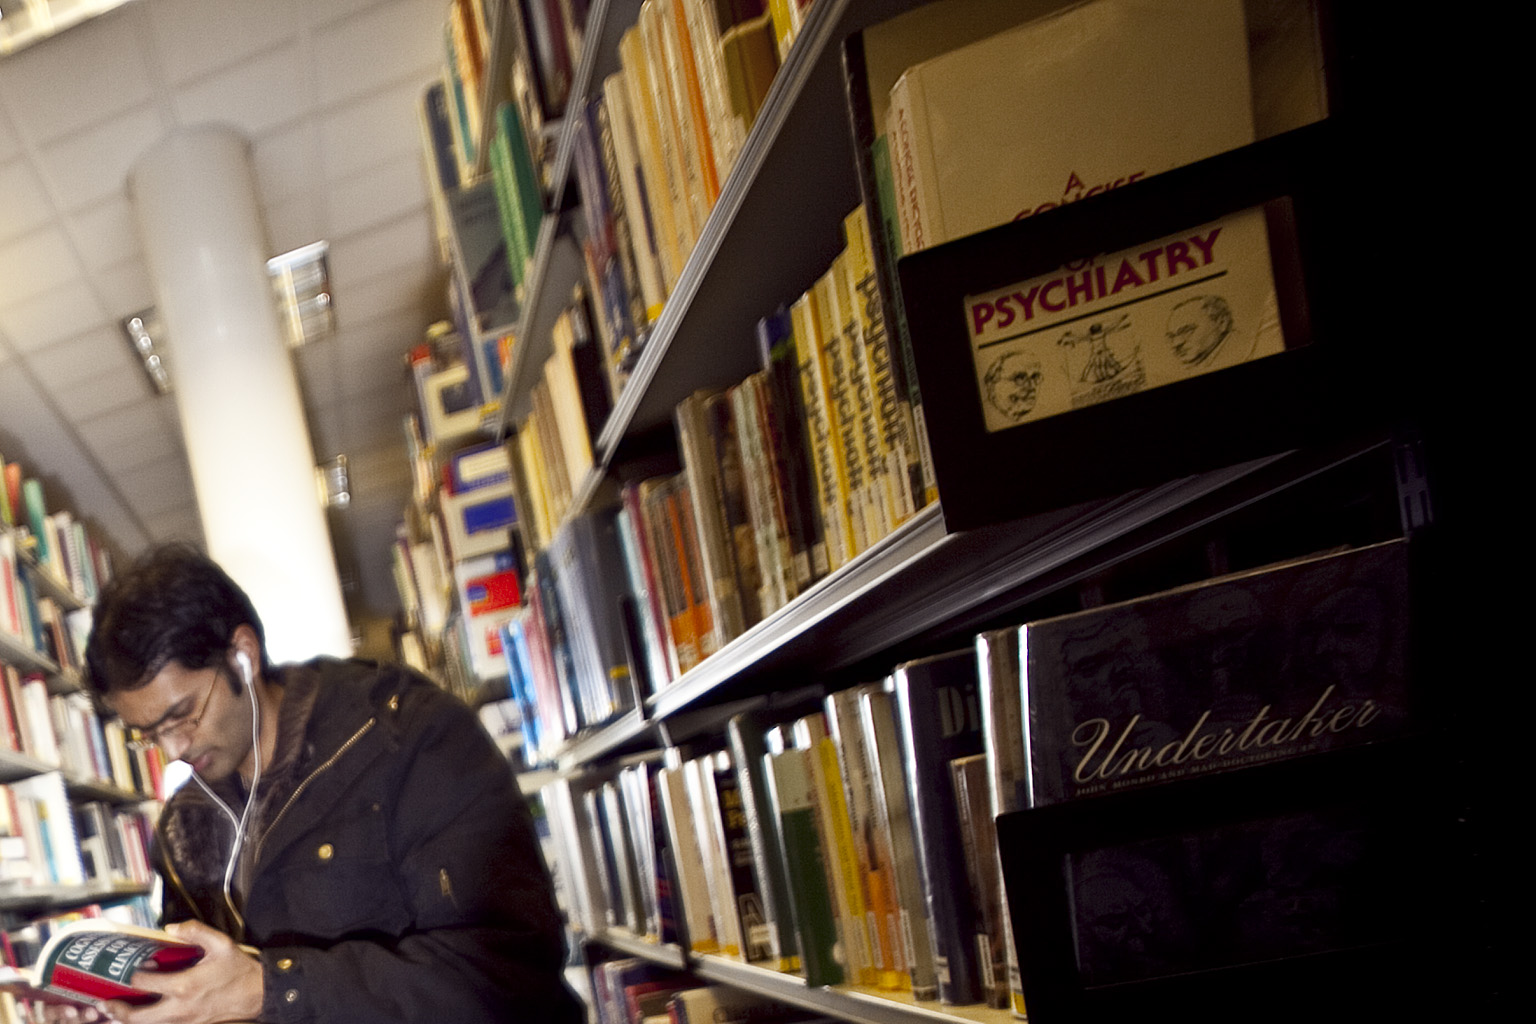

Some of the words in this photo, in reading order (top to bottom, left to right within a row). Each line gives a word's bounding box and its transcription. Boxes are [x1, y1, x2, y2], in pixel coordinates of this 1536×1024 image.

[1064, 171, 1084, 196] A
[972, 227, 1222, 335] PSYCHIATRY
[843, 317, 888, 503] psychiatr
[856, 269, 901, 472] psychiatr
[825, 336, 864, 514] psychiatr
[938, 683, 980, 739] Di
[1072, 683, 1381, 784] Undertaker
